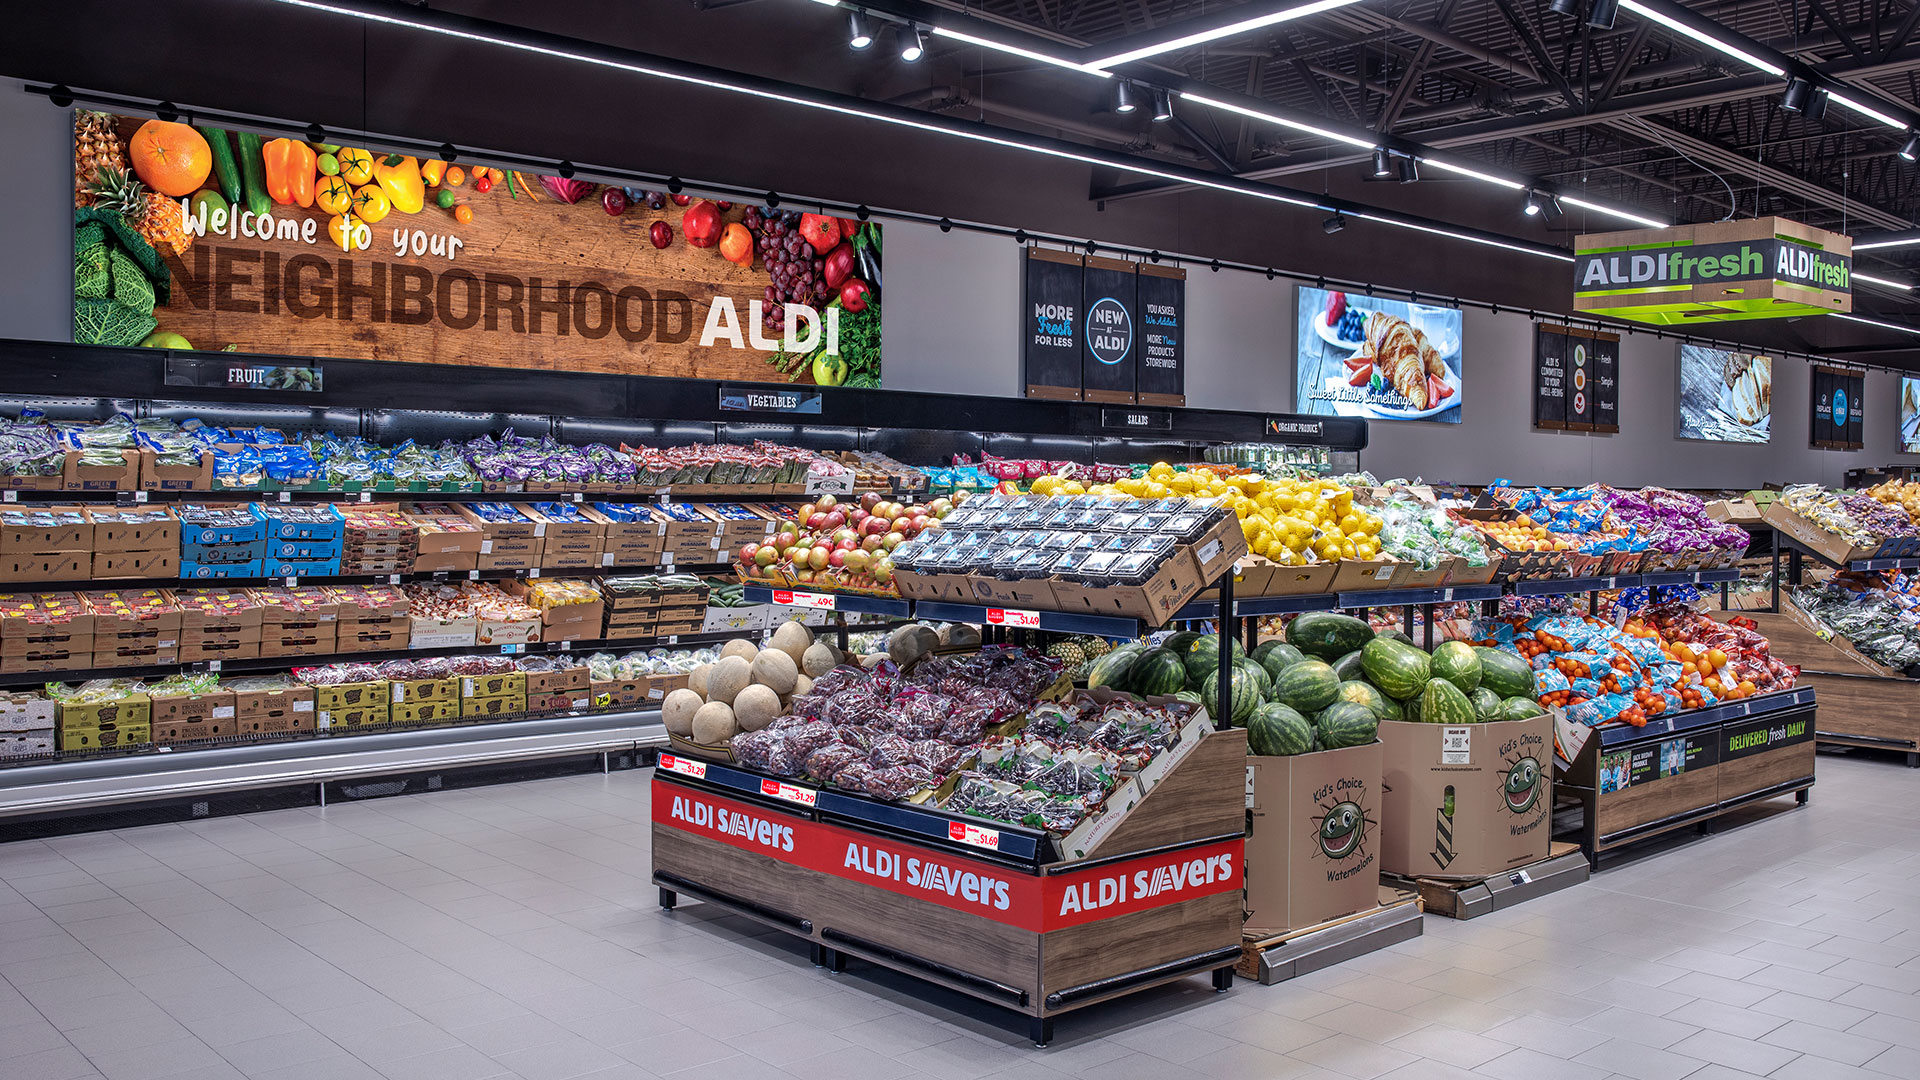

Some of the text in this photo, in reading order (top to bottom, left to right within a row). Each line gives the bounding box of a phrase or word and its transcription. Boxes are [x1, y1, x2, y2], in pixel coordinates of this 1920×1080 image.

[182, 198, 464, 260] Welcome to your
[163, 241, 693, 345] NEIGHBORHOOD
[1035, 303, 1074, 321] MORE
[1095, 309, 1125, 325] NEW
[1146, 304, 1176, 317] YOU ASKED,
[699, 296, 839, 356] ALDI
[1037, 316, 1073, 336] Fresh
[1145, 315, 1156, 325] We
[1105, 326, 1113, 334] AT
[1035, 335, 1073, 347] FOR LESS
[1094, 335, 1125, 351] ALDI
[1146, 334, 1162, 344] MORE
[1148, 345, 1175, 357] PRODUCTS
[1145, 357, 1177, 369] STOREWIDE!
[228, 368, 265, 384] FRUIT
[748, 394, 797, 408] VEGETABLES
[1308, 384, 1337, 400] Sweet
[1337, 386, 1363, 403] Little
[1127, 414, 1149, 426] SALADS
[1278, 421, 1318, 433] ORGANIC PRODUCE
[817, 597, 833, 606] 49¢
[1020, 615, 1040, 625] $1.49
[182, 702, 208, 710] PRODUCE
[1729, 721, 1806, 752] DELIVERED fresh DAILY
[1498, 732, 1543, 758] Kid's Choice
[687, 764, 705, 776] $1.29
[795, 791, 815, 804] $1.29
[1313, 776, 1364, 803] Kid's Choice
[671, 796, 713, 829] ALDI
[1510, 808, 1548, 836] Watermelons
[980, 833, 998, 846] $1.69
[844, 843, 900, 882] ALDI
[1327, 853, 1374, 882] Watermelons
[1059, 875, 1126, 916] ALDI
